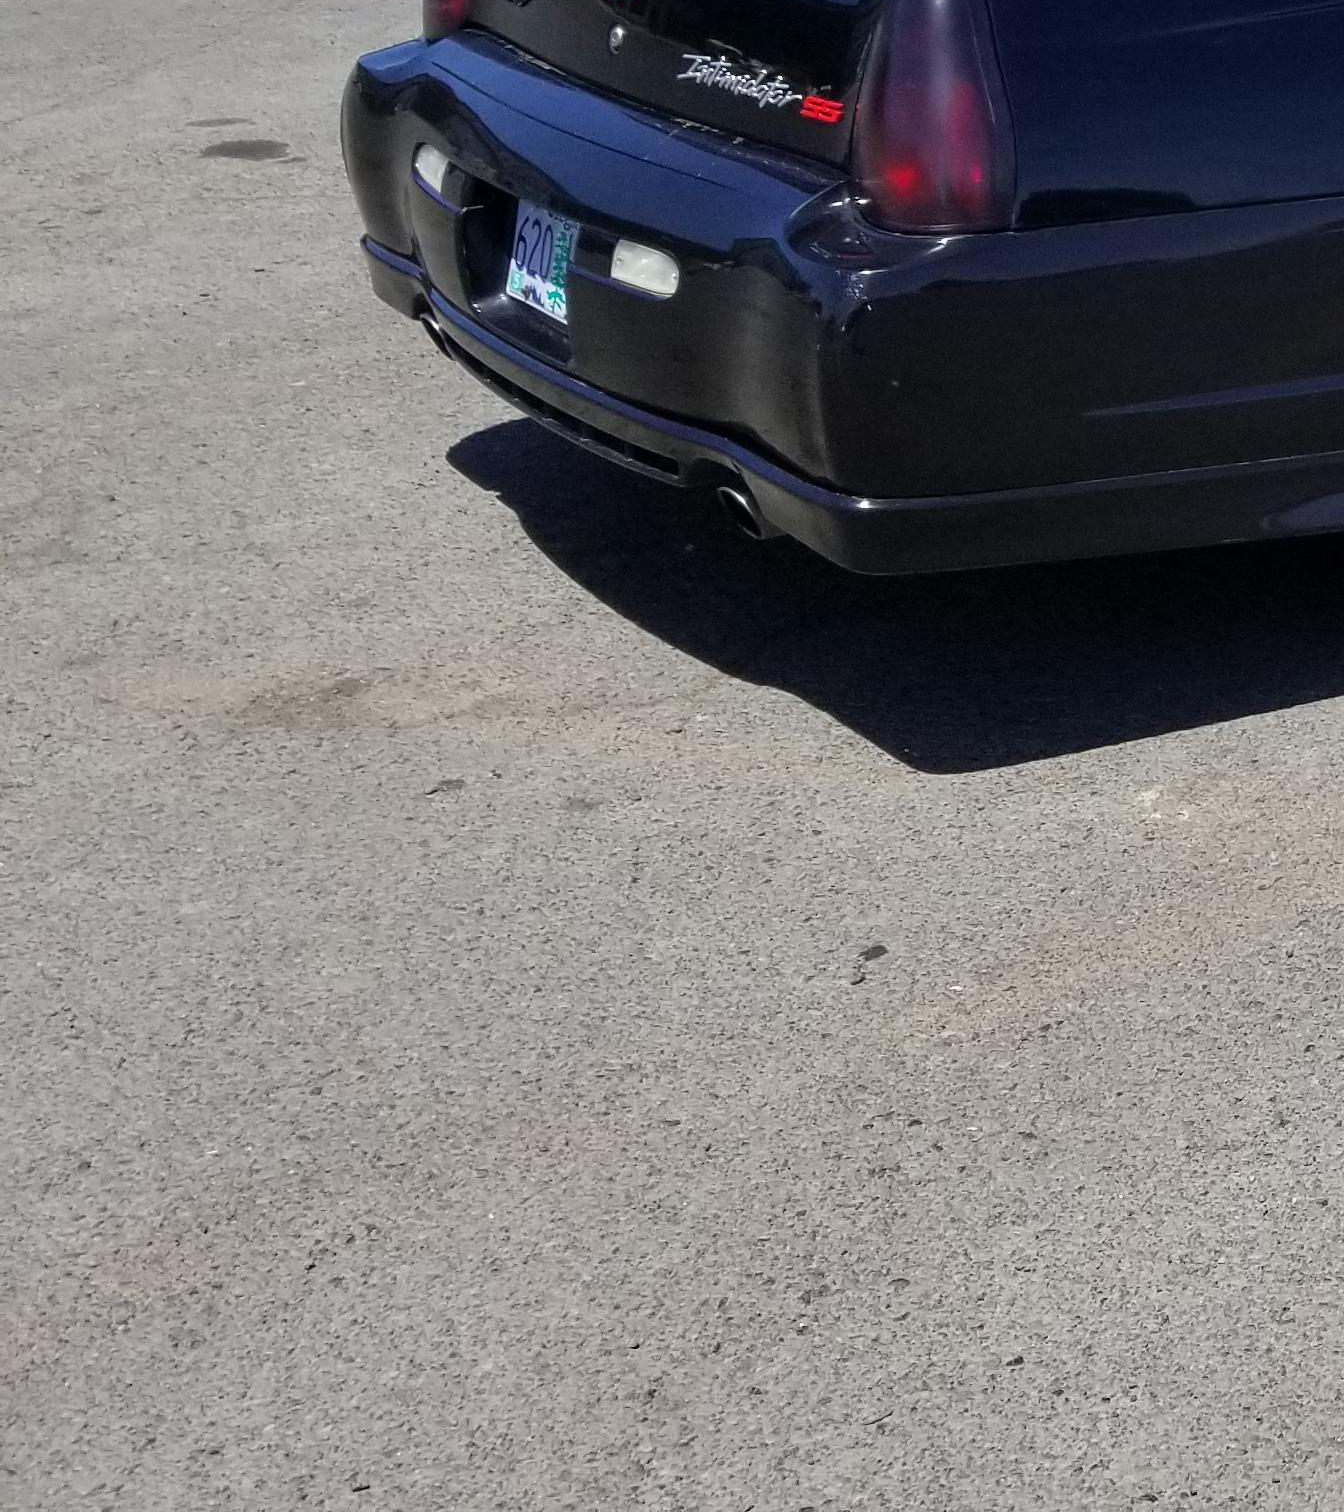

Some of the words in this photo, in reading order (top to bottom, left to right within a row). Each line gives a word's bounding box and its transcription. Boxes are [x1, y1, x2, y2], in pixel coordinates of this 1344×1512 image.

[676, 53, 803, 109] Intimidator
[800, 95, 844, 124] SS
[515, 215, 554, 282] 620
